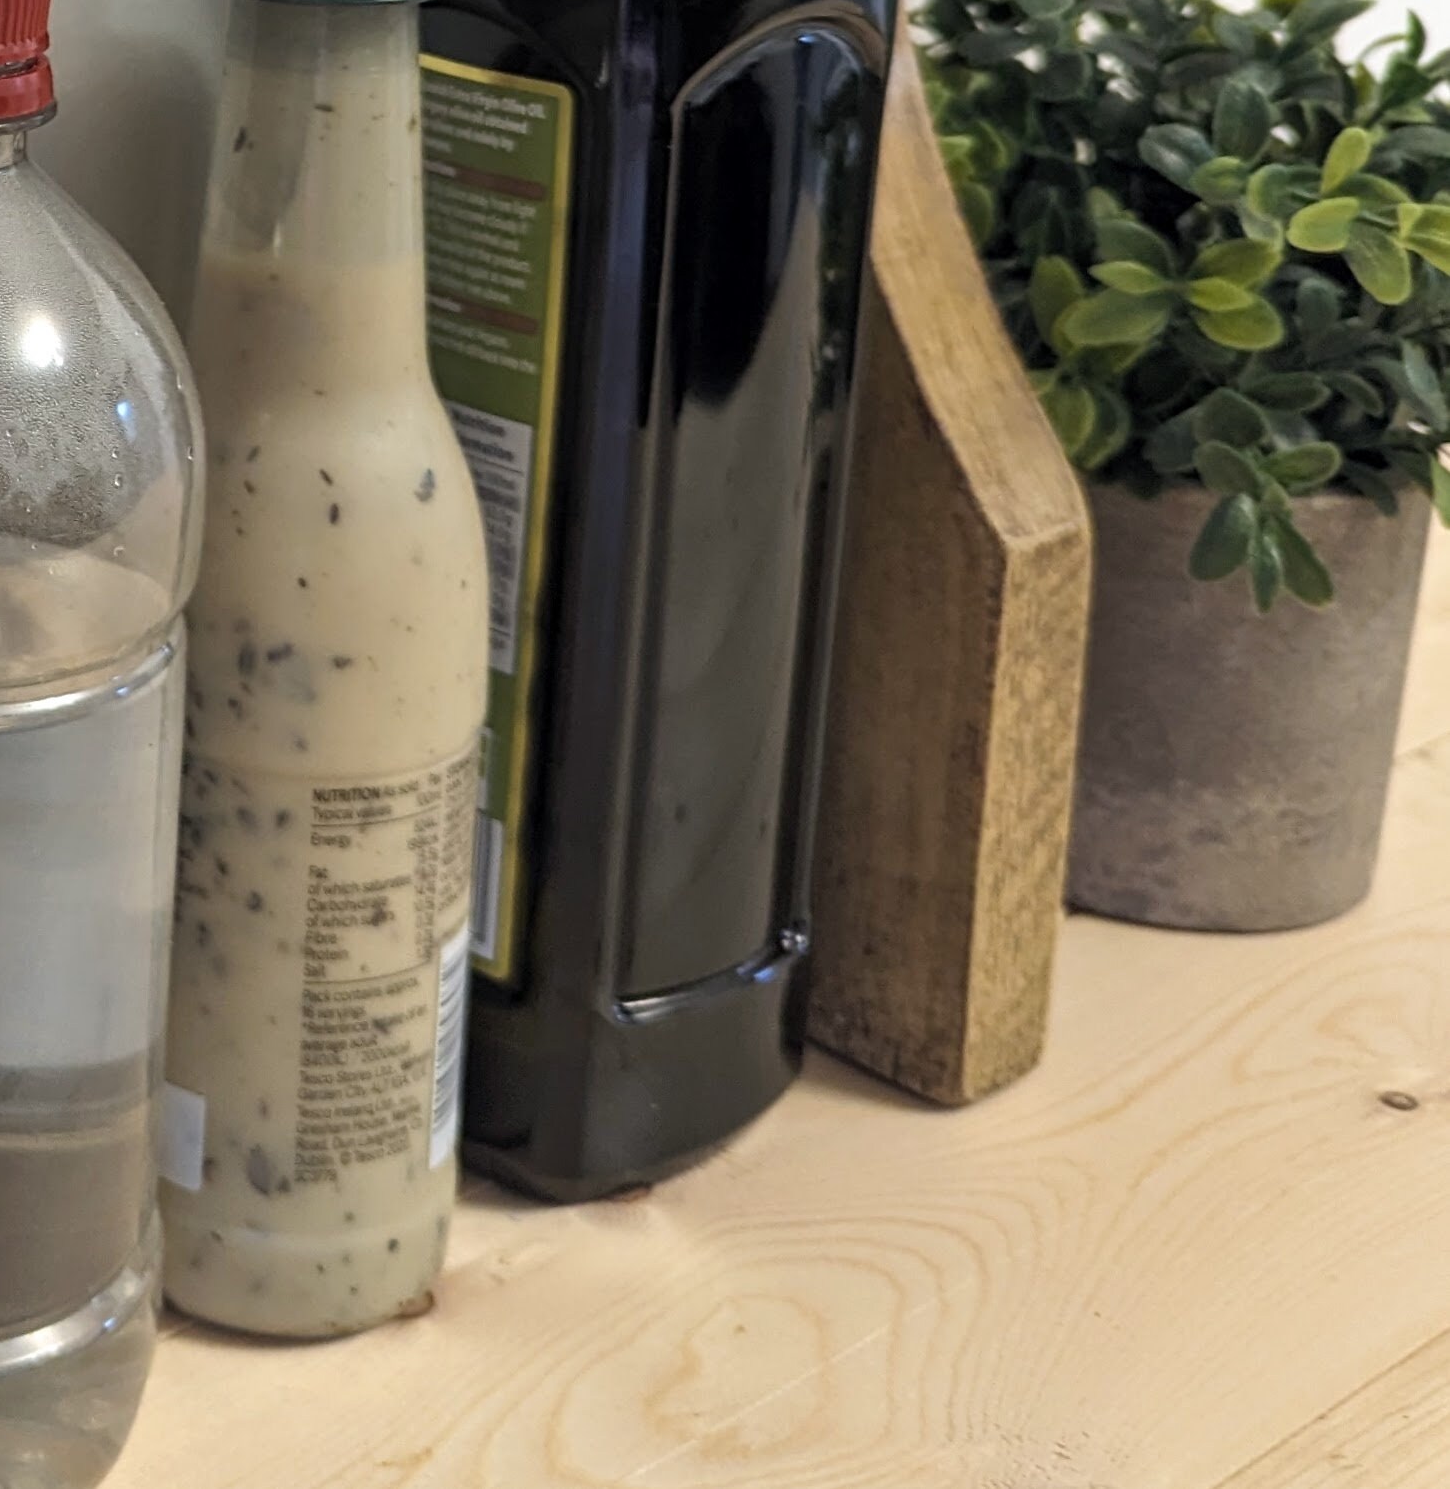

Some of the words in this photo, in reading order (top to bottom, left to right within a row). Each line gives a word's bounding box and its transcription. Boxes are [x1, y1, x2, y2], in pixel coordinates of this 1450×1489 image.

[313, 786, 380, 802] NUTRITION
[312, 806, 353, 821] Typical
[310, 832, 351, 848] Energy
[308, 865, 328, 879] Fat
[323, 883, 358, 895] which
[322, 914, 358, 927] which
[305, 930, 337, 944] Fibre
[303, 946, 349, 960] Protein
[303, 962, 326, 977] Salt
